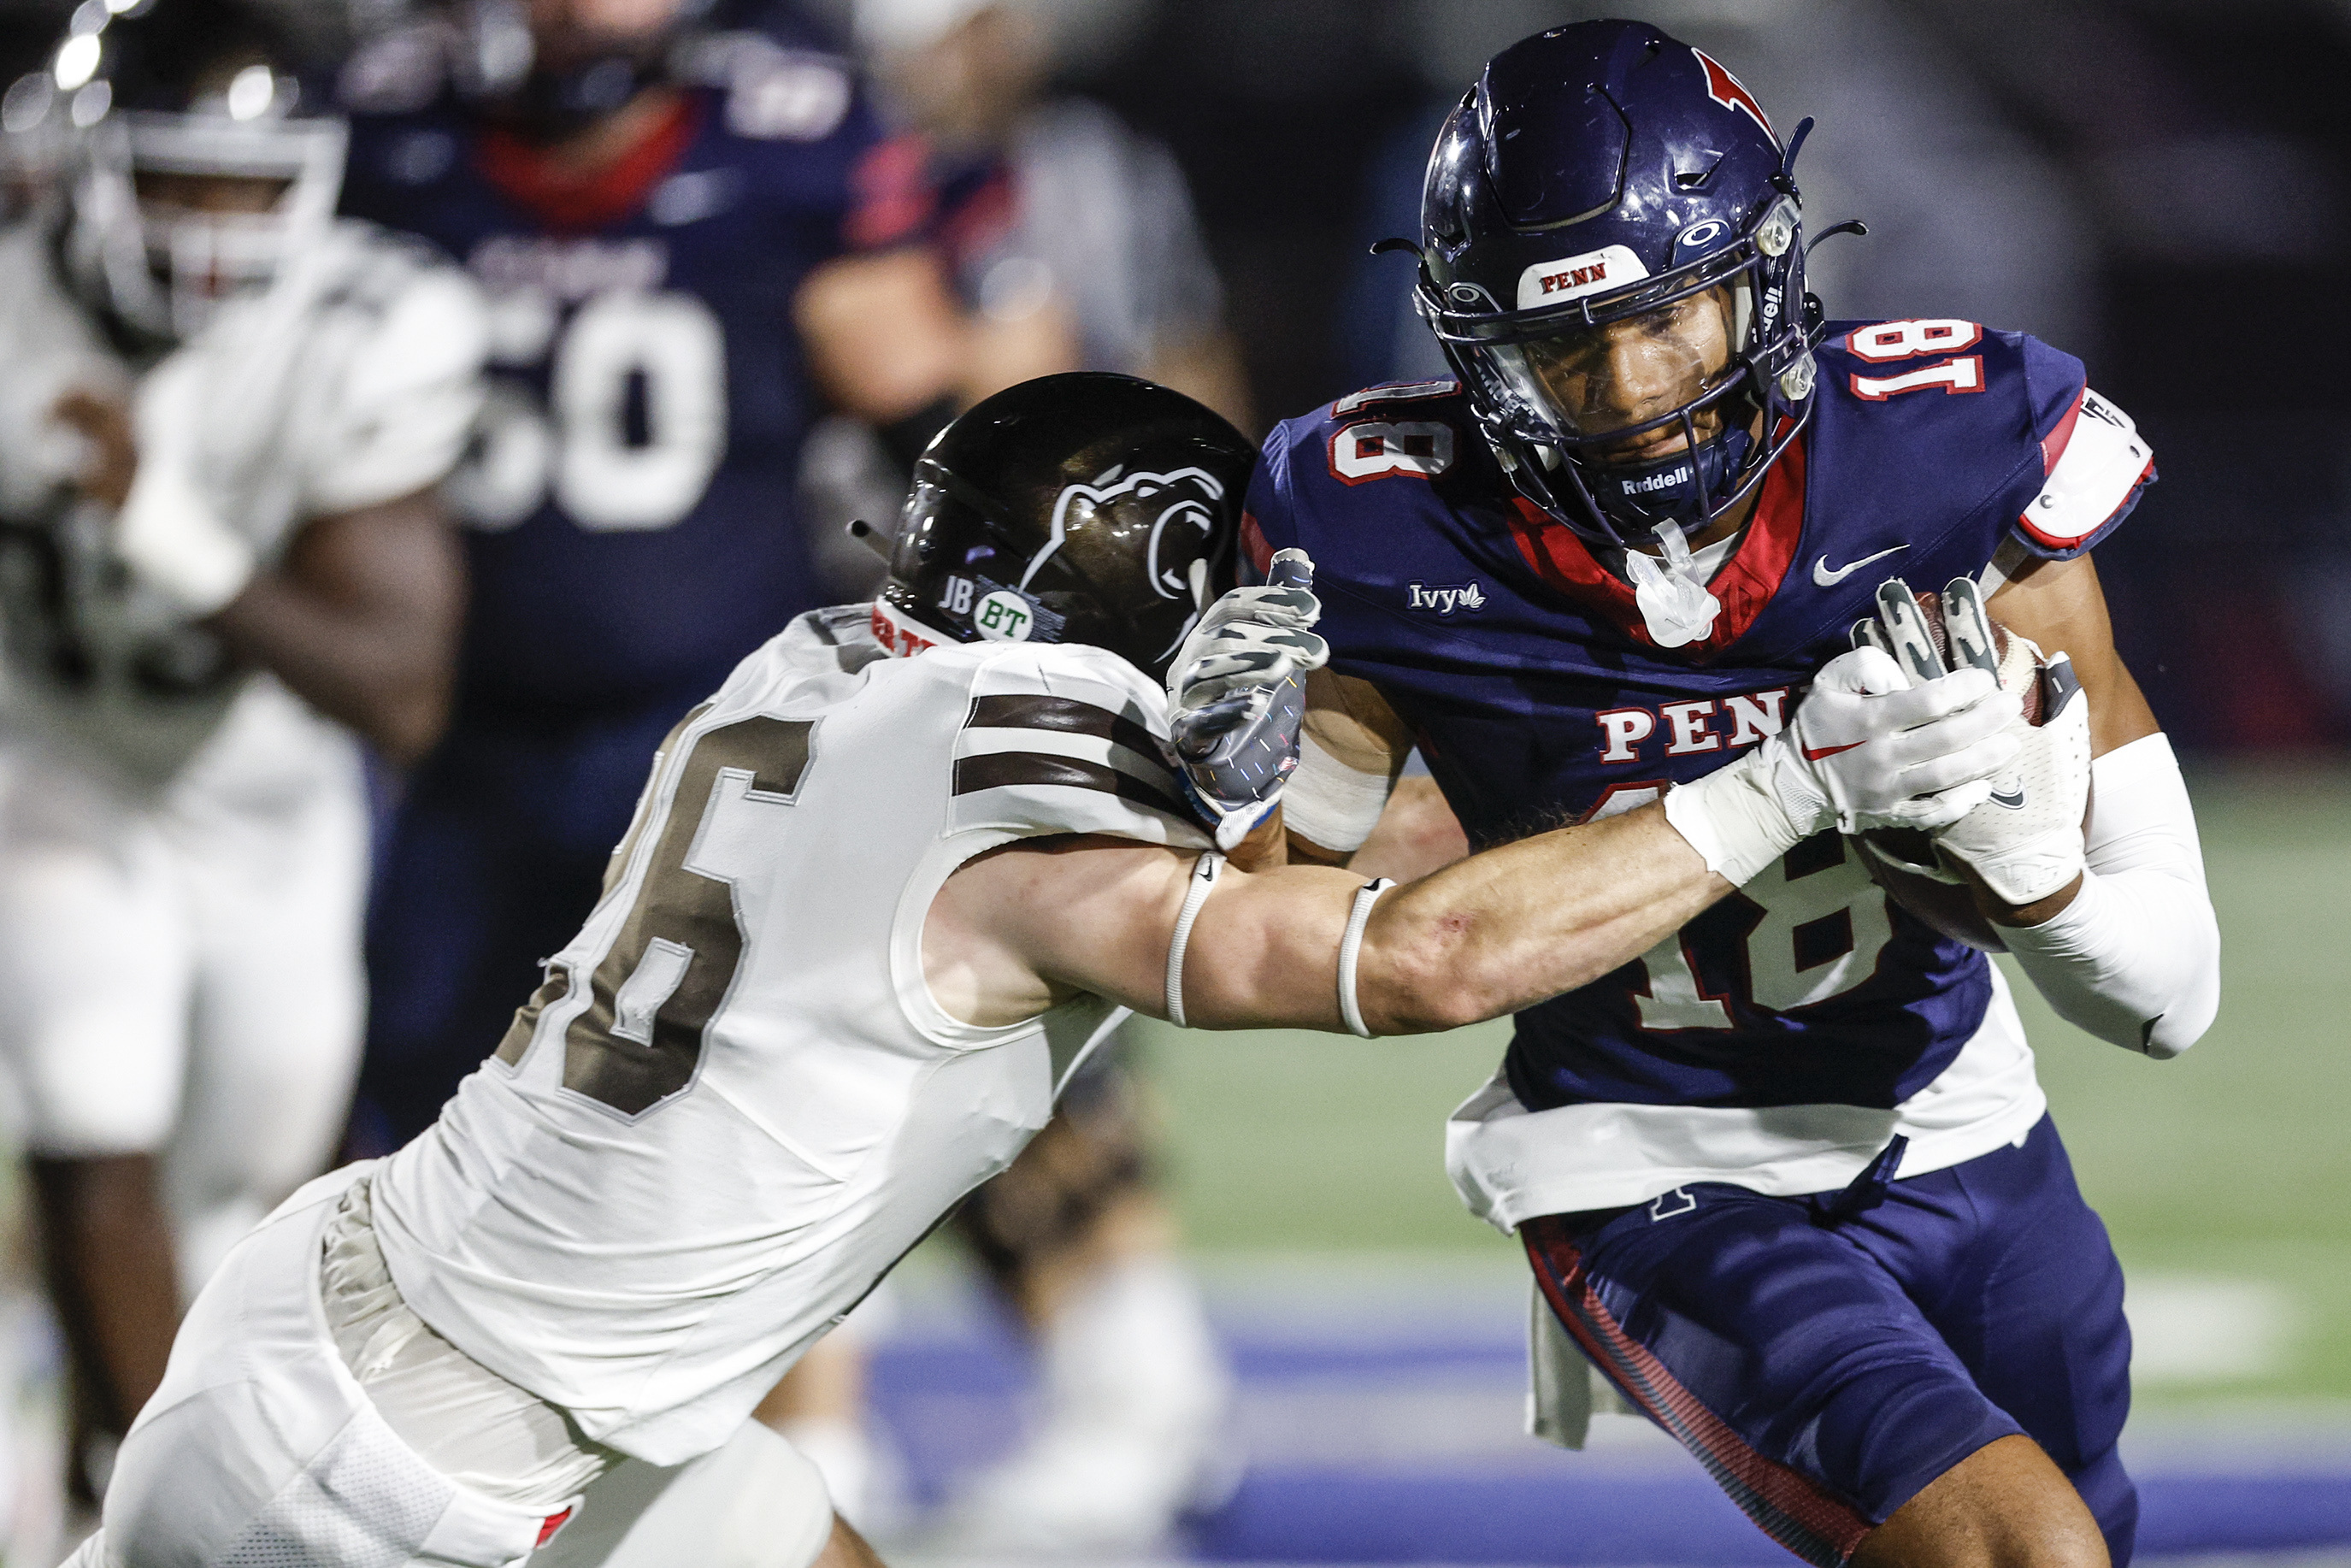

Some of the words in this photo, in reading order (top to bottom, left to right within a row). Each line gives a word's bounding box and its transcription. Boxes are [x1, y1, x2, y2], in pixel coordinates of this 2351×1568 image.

[1539, 262, 1606, 295] PENN
[1845, 317, 1986, 402] 18
[1328, 381, 1463, 487] 18
[1621, 466, 1688, 495] Riddell
[937, 575, 975, 615] JB
[1409, 584, 1458, 614] Ivy
[980, 598, 1028, 638] BT
[1594, 686, 1806, 765] PEN
